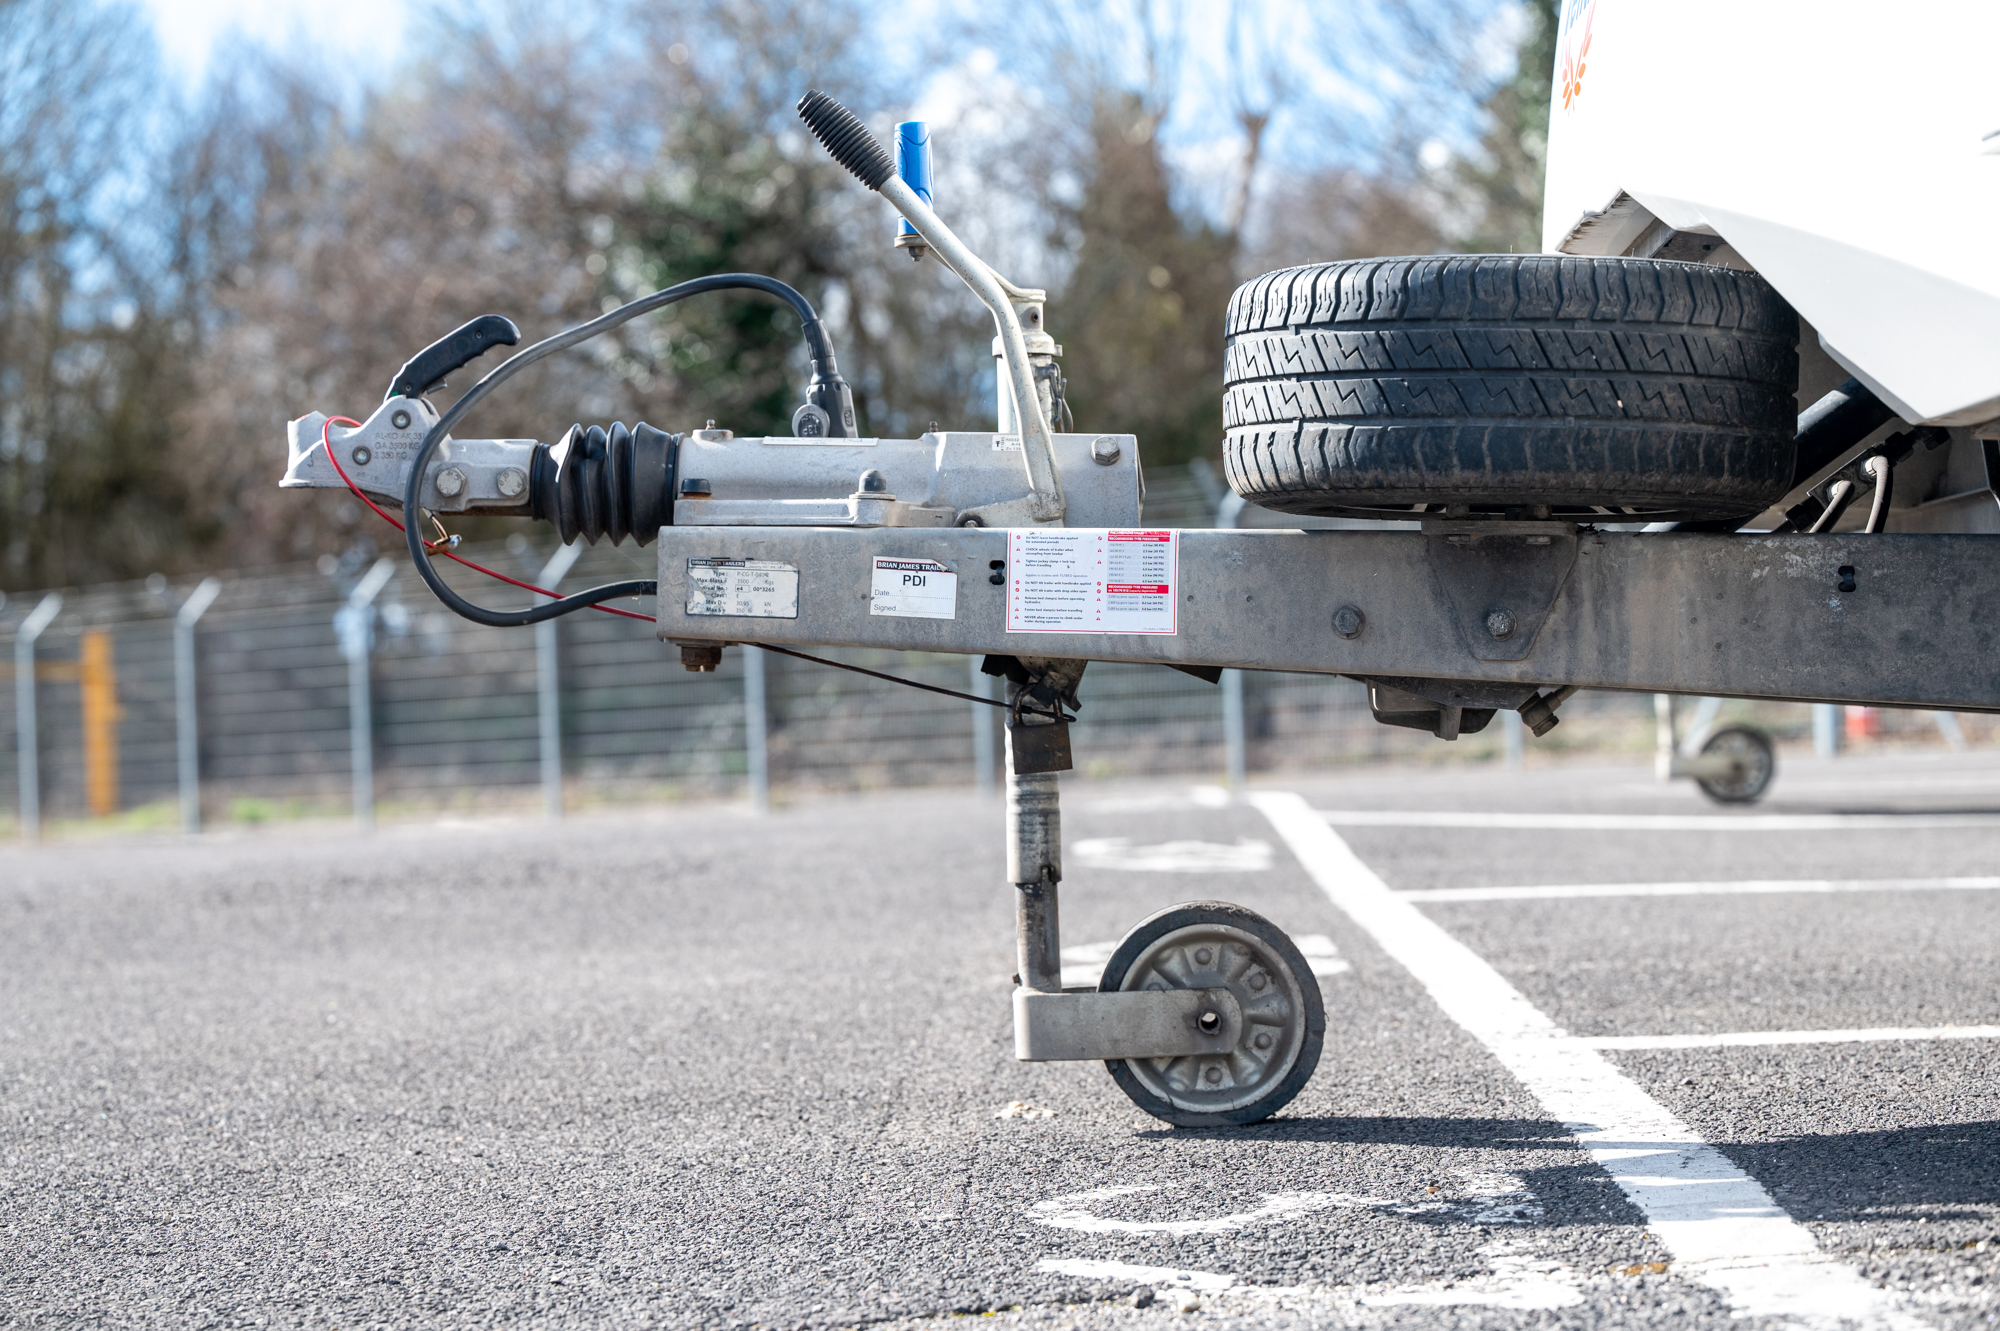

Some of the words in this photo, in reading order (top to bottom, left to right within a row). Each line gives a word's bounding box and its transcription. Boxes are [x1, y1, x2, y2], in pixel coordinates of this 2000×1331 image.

[375, 432, 398, 440] AL-KO
[401, 432, 411, 440] AK
[389, 442, 407, 450] 3500
[408, 442, 421, 450] KG
[380, 452, 394, 460] 350
[396, 452, 407, 461] KG
[877, 561, 898, 569] BRIAN
[898, 562, 920, 570] JAMES
[903, 574, 926, 587] PDI
[874, 589, 890, 597] Date
[873, 604, 897, 613] Signed
